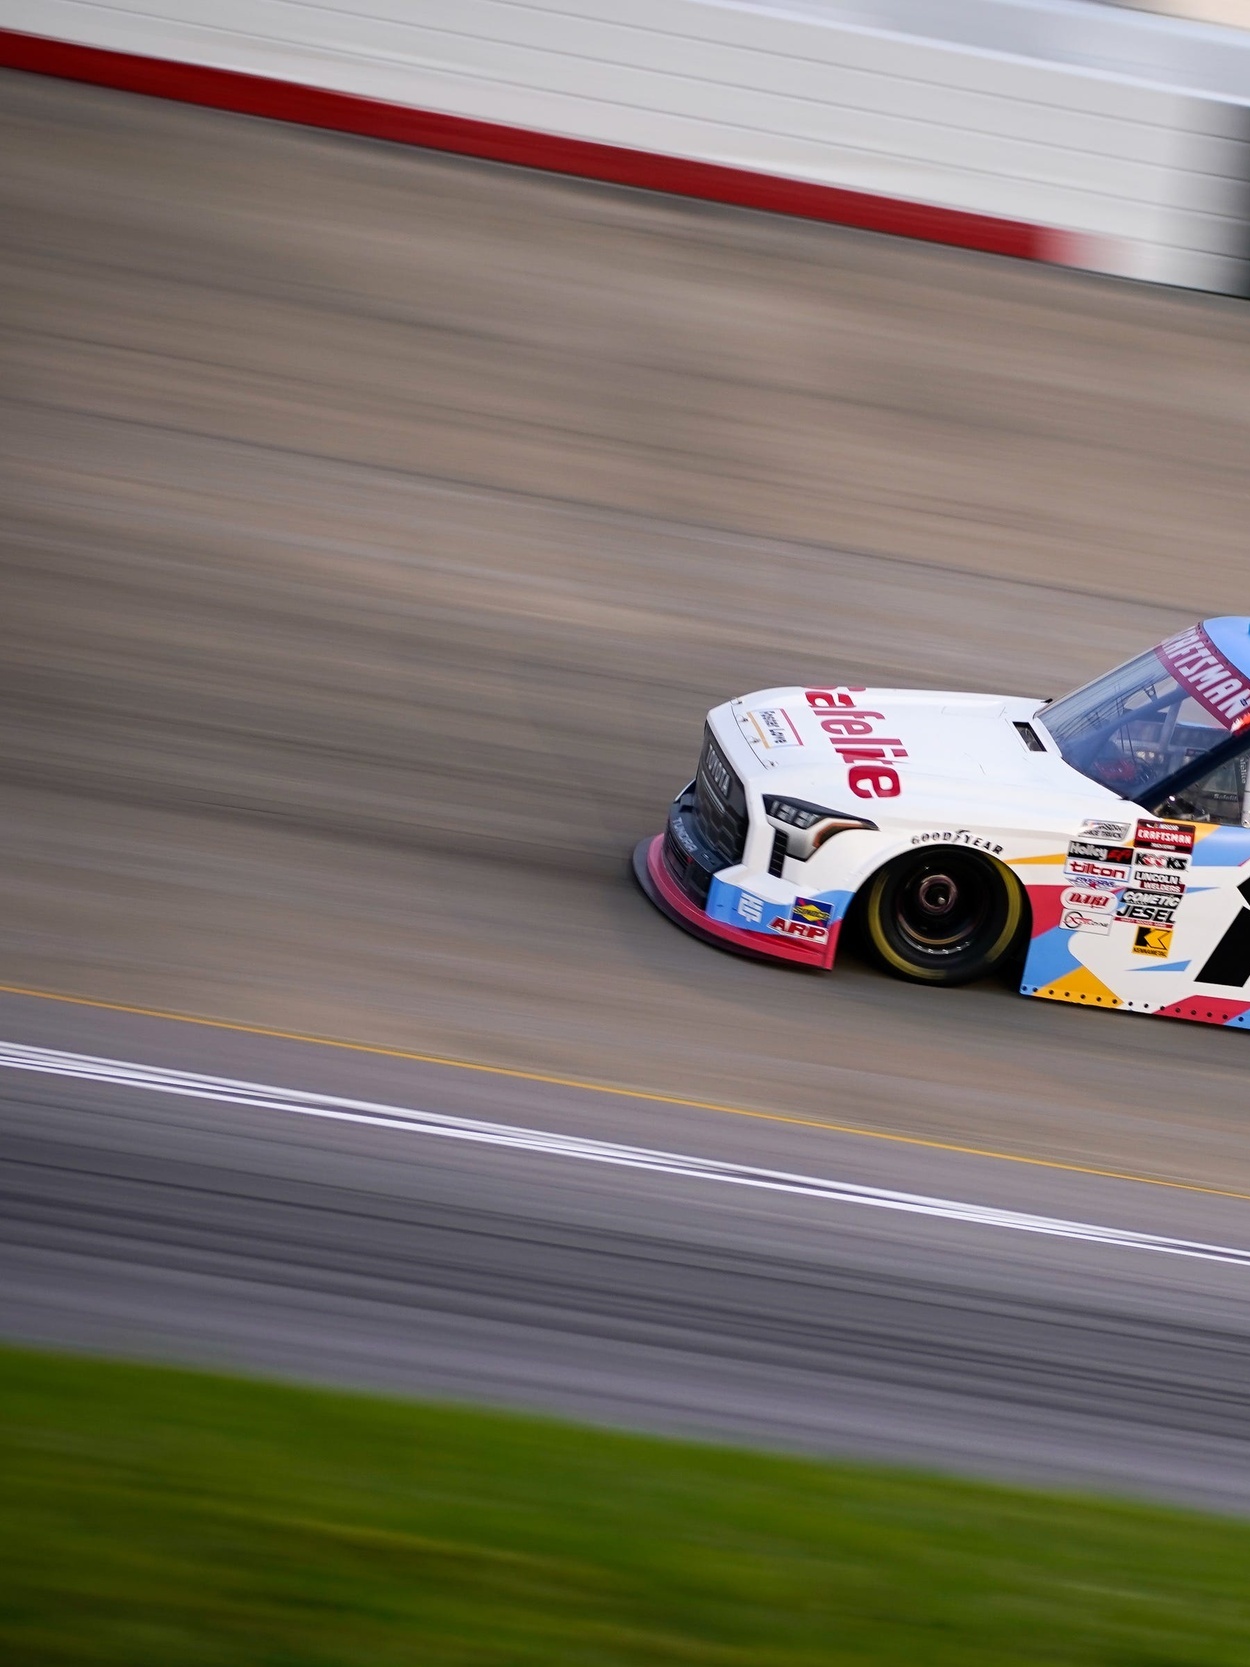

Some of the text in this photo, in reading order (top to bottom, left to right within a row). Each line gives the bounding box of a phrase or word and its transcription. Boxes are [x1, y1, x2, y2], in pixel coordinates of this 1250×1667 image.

[673, 817, 698, 852] TUNDRA
[1137, 829, 1192, 844] CRAFTSMAN
[1069, 842, 1108, 861] Holley
[1135, 852, 1188, 870] KOOKS
[1070, 862, 1125, 879] tilton
[1135, 871, 1181, 884] LINCOLN
[1143, 882, 1181, 893] WELDERS
[1122, 890, 1181, 908] COMETIC
[1117, 905, 1175, 924] JESEL
[771, 916, 827, 939] ARP
